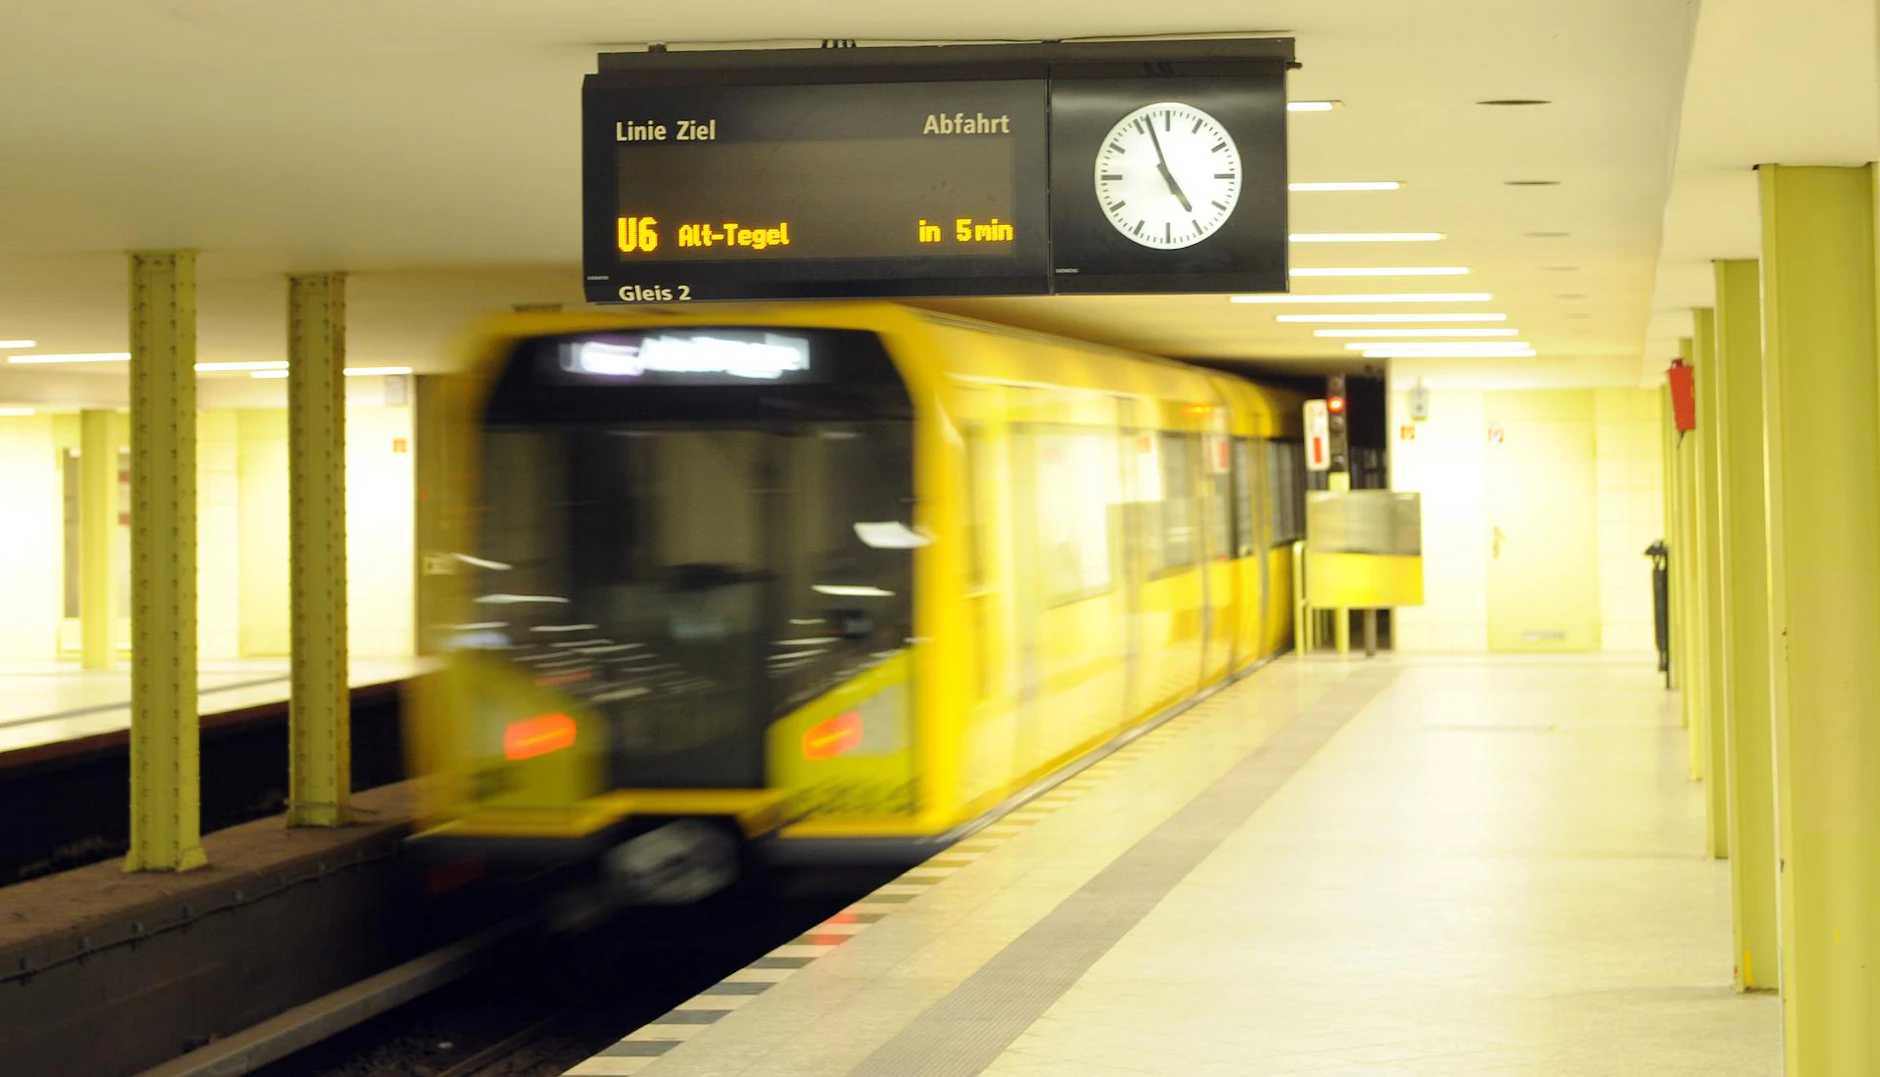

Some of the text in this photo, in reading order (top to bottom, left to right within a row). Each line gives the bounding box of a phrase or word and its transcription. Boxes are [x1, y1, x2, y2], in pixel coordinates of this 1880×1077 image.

[616, 119, 716, 142] Linie Ziel
[923, 113, 1010, 134] Abfahrt
[618, 216, 790, 252] U6 Alt-Tegel
[919, 218, 1014, 242] in 5 min
[618, 285, 692, 301] Gleis 2
